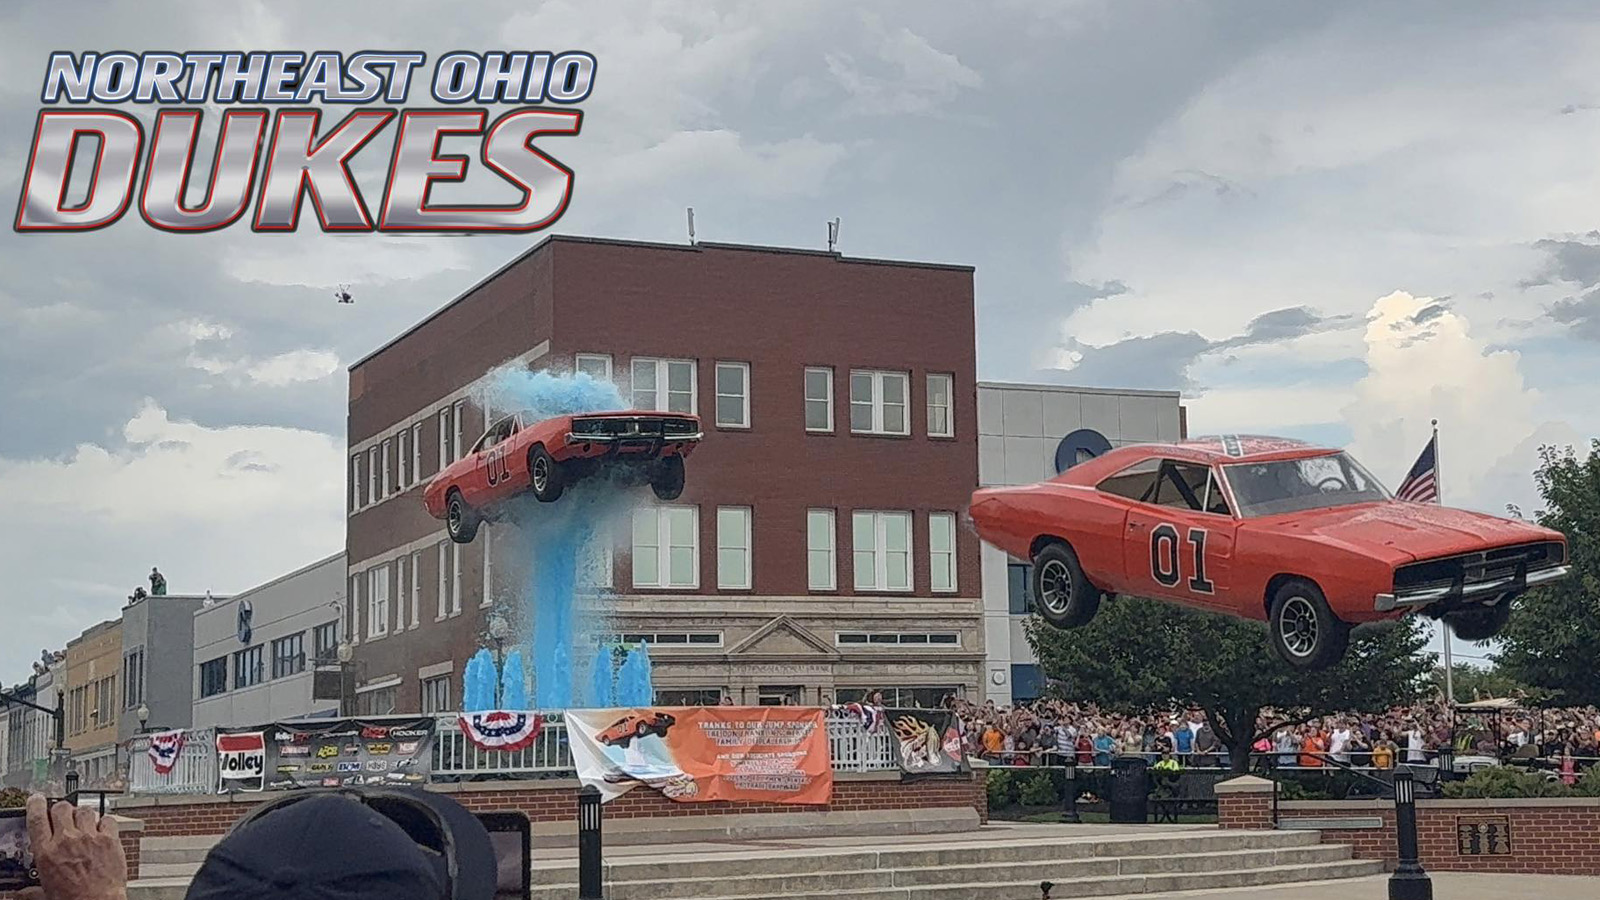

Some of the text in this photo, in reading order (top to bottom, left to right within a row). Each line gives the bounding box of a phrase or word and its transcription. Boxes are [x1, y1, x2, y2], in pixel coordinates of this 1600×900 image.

[486, 444, 511, 487] 01
[1150, 522, 1215, 595] 01
[698, 722, 731, 730] THANKS
[735, 722, 745, 730] TO
